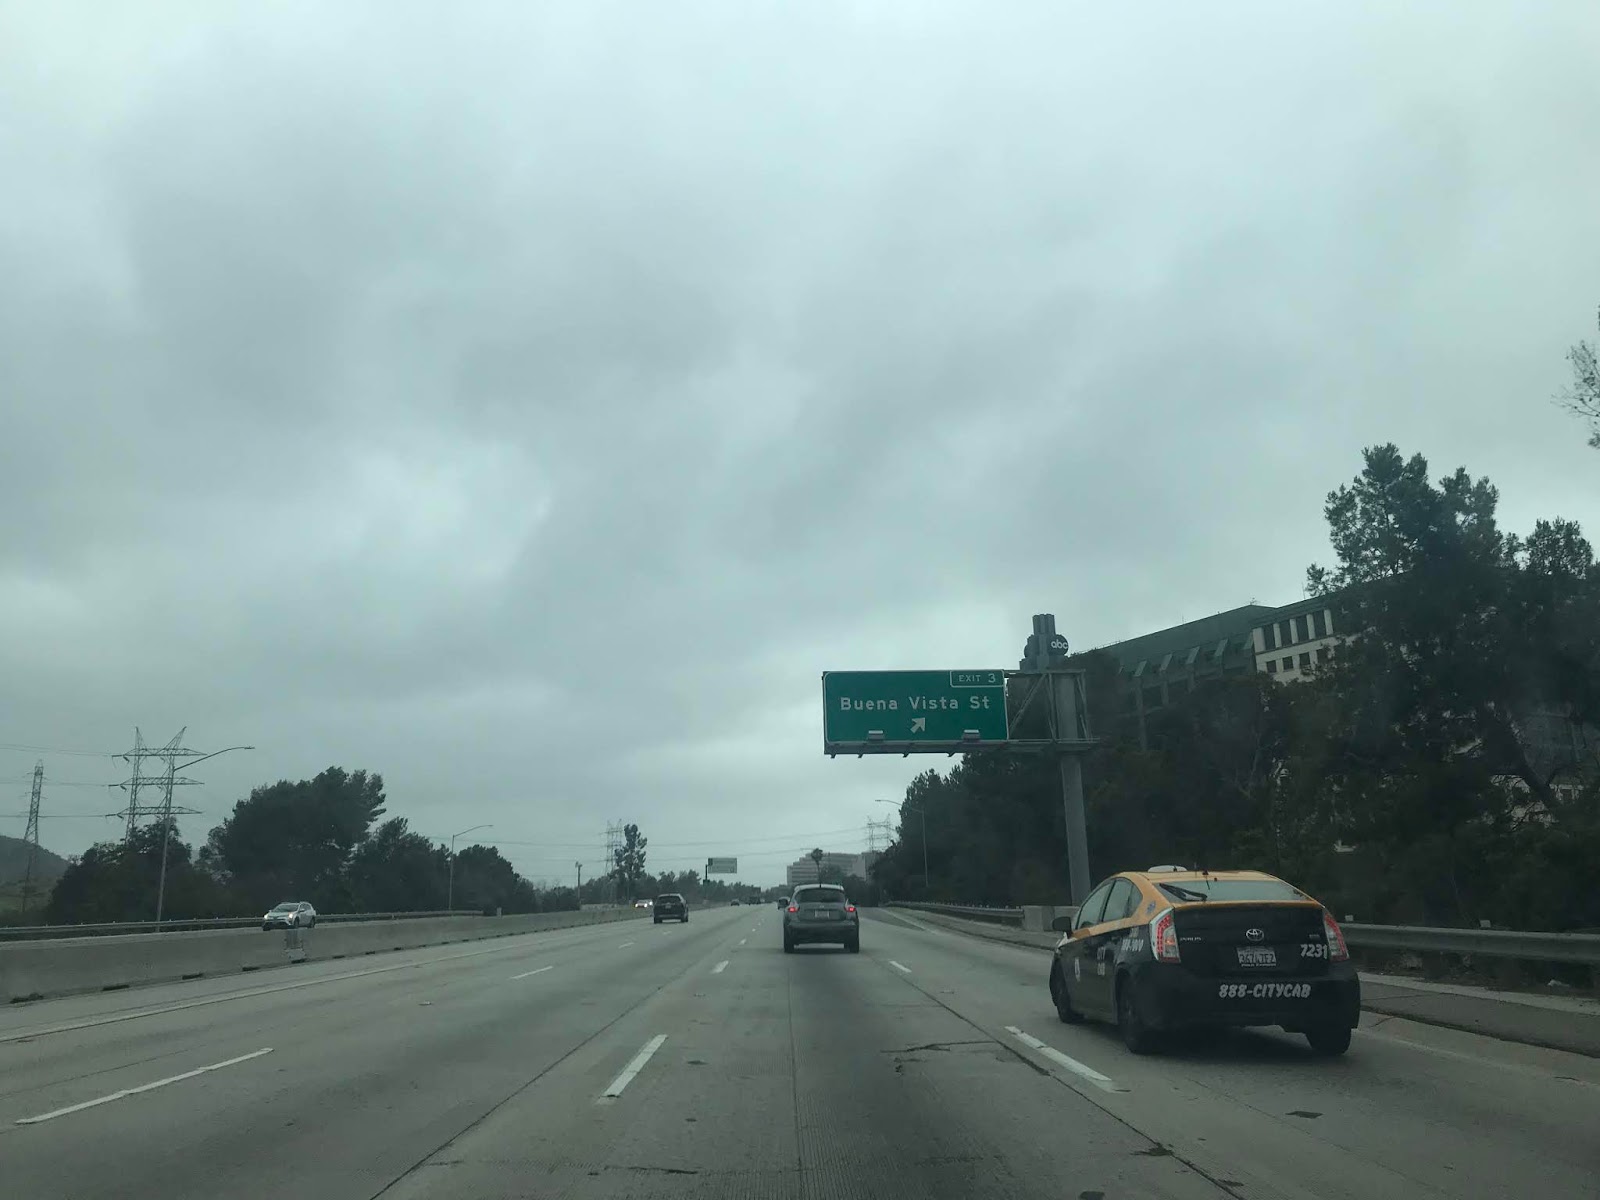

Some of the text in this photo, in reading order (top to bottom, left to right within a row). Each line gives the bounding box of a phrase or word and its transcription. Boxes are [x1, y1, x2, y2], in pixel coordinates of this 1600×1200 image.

[1050, 638, 1069, 650] abc
[958, 673, 996, 684] EXIT 3
[840, 695, 990, 711] Buena Vista St
[1300, 943, 1328, 960] 7231
[1218, 983, 1312, 999] 888-CITYCAB
